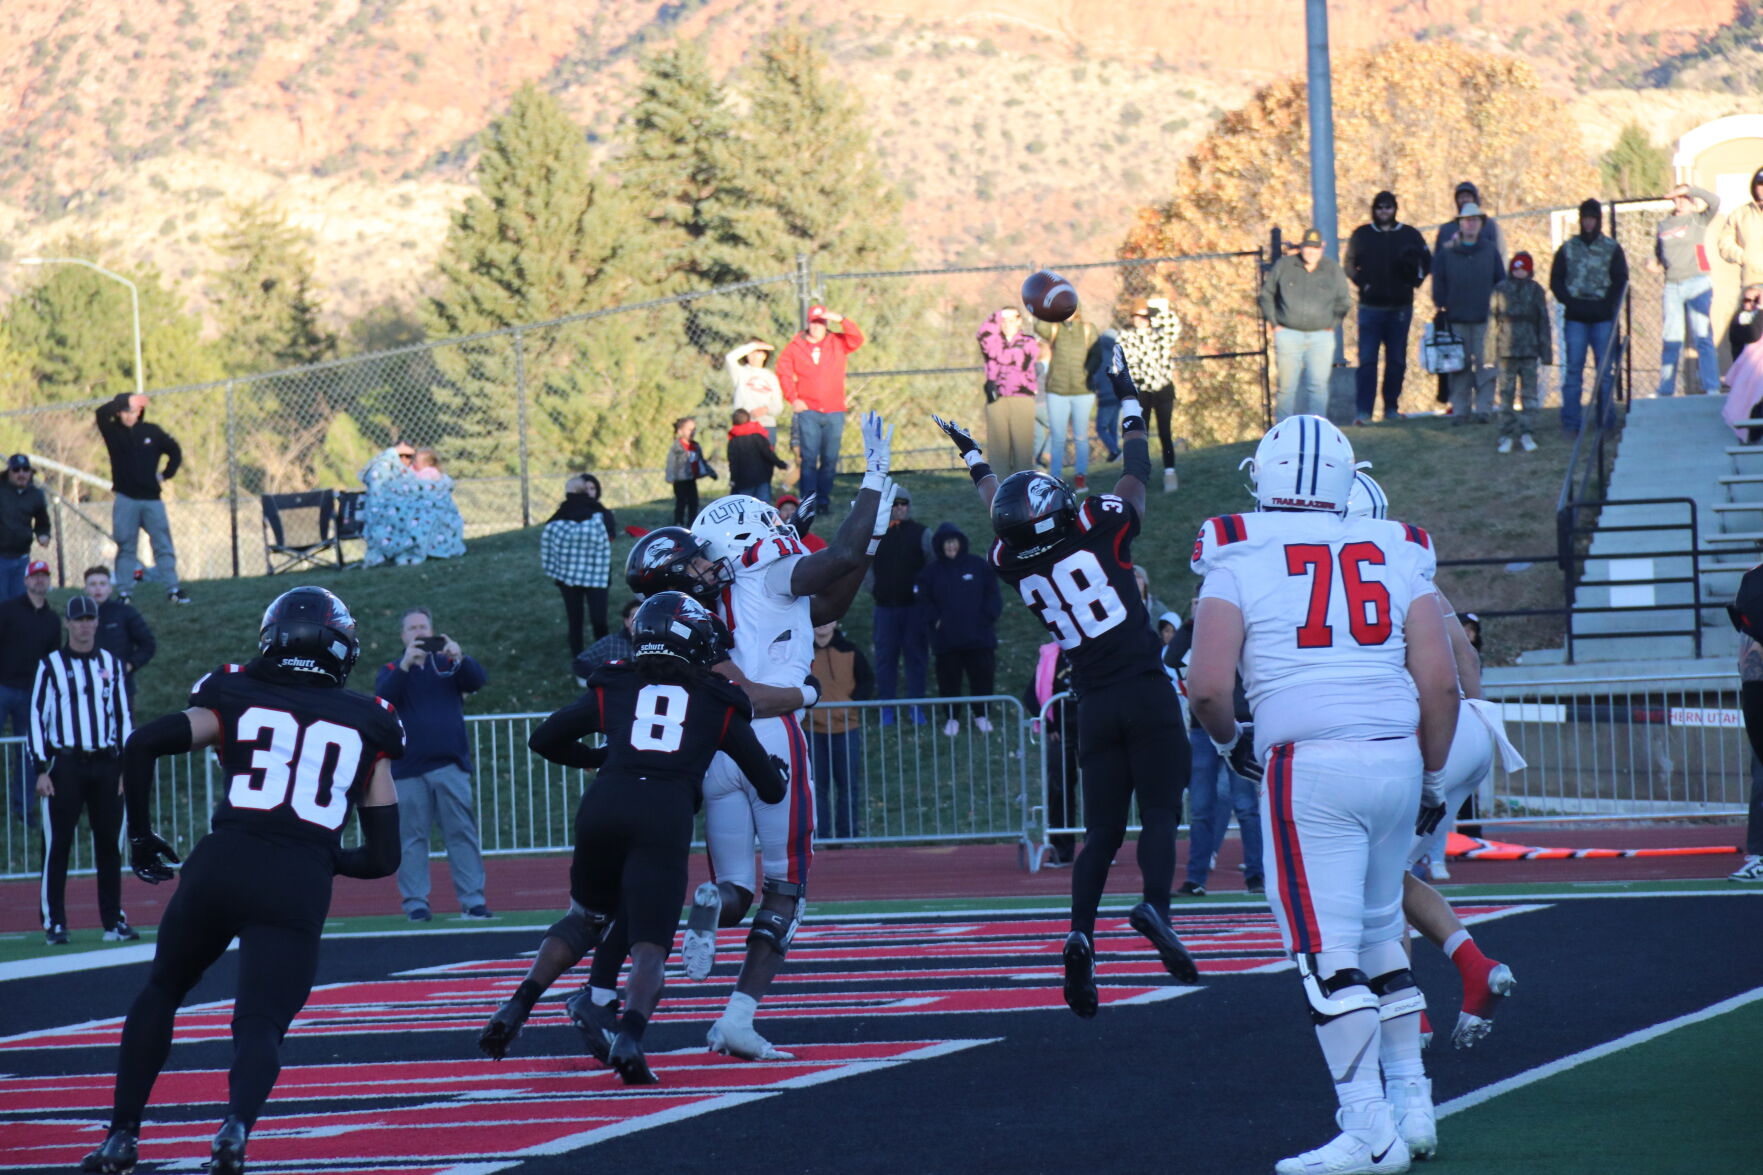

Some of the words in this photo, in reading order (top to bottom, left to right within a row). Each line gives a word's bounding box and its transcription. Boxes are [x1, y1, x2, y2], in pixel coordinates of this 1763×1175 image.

[709, 499, 745, 524] UT
[1272, 497, 1336, 510] TRAILBLAZERS
[772, 537, 803, 556] 11
[1019, 549, 1128, 651] 38
[1283, 541, 1393, 649] 76
[281, 656, 316, 668] schutt
[630, 683, 690, 754] 8
[1707, 710, 1741, 724] UTAH
[228, 706, 363, 831] 30
